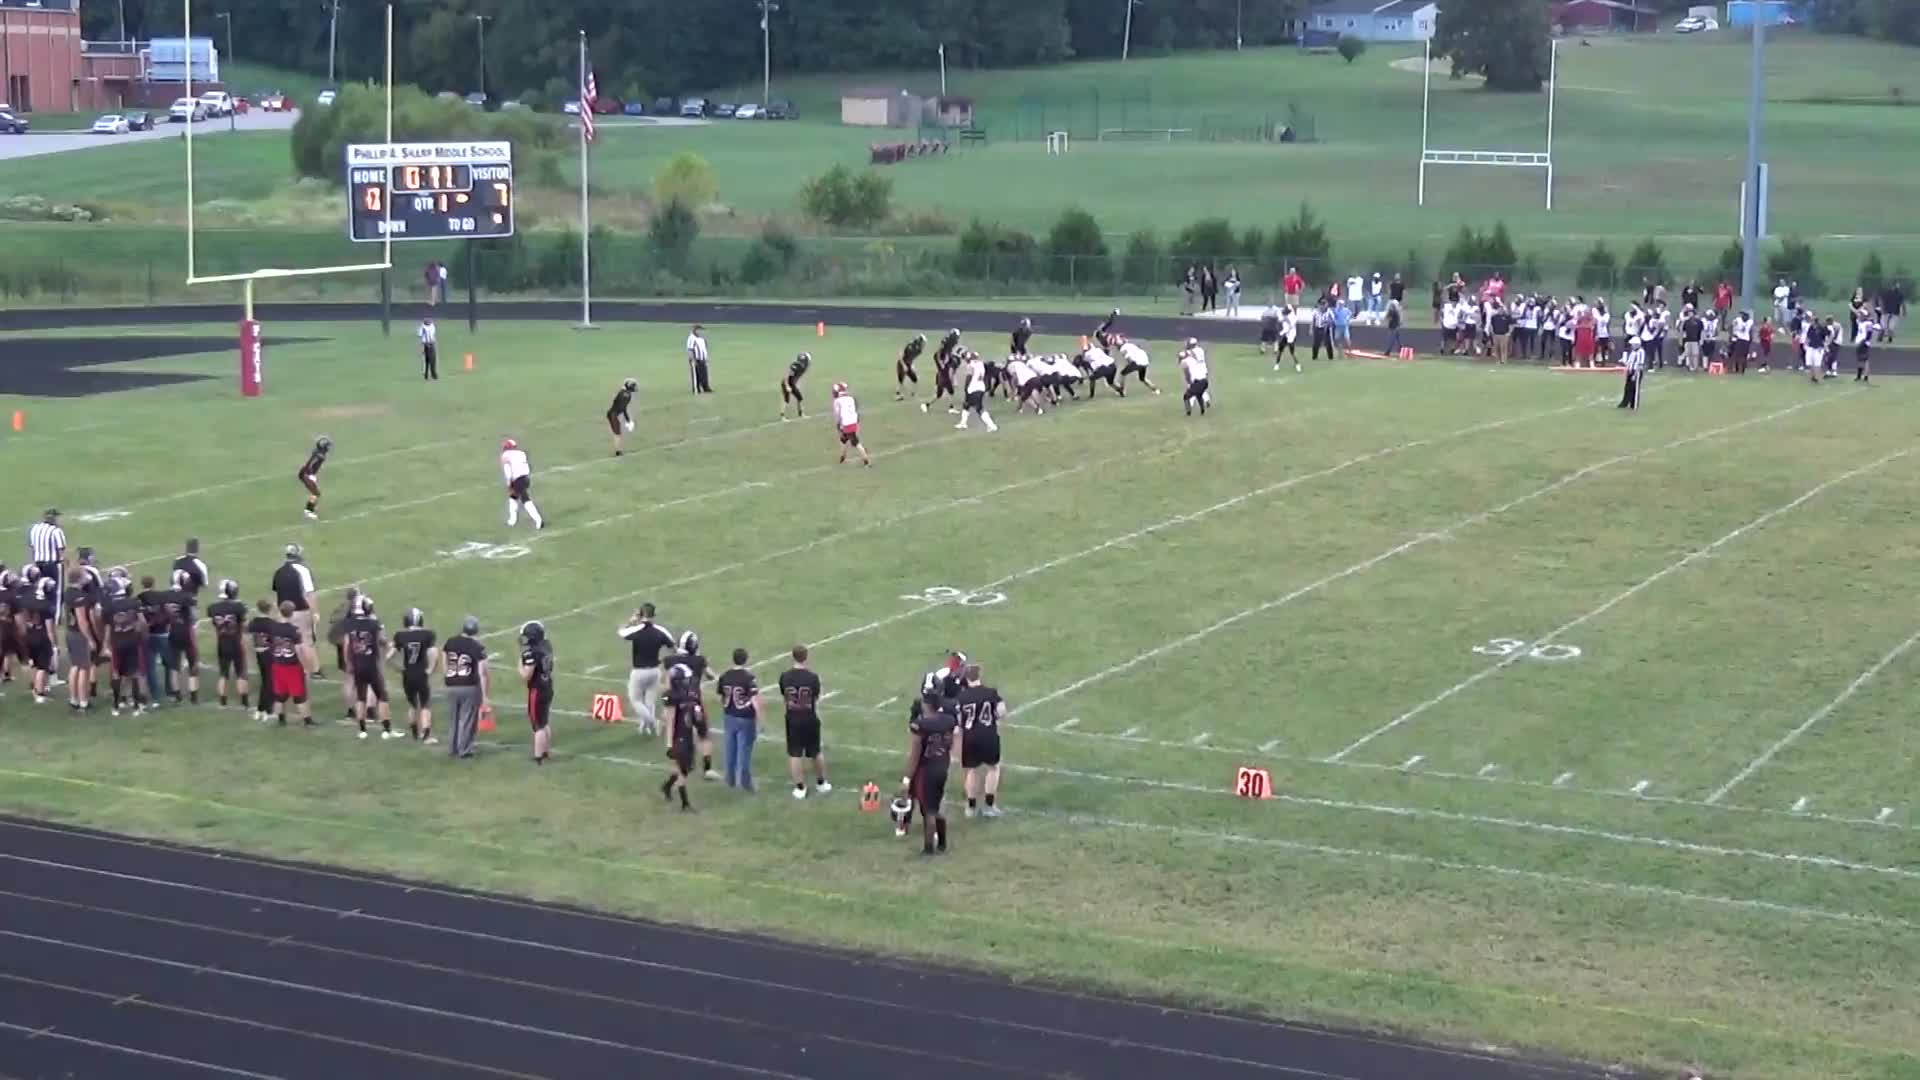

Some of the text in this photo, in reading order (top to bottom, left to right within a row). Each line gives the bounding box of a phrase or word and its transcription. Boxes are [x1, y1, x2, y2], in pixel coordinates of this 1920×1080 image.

[353, 169, 386, 183] HOME
[472, 167, 509, 180] VISITOR
[414, 197, 434, 212] QTR
[493, 183, 508, 206] 7
[377, 220, 406, 234] DWN
[448, 217, 475, 231] TO GO
[407, 641, 421, 665] 7
[1472, 638, 1582, 660] 30
[595, 697, 614, 720] 20
[962, 701, 993, 730] 74
[1239, 770, 1264, 797] 30
